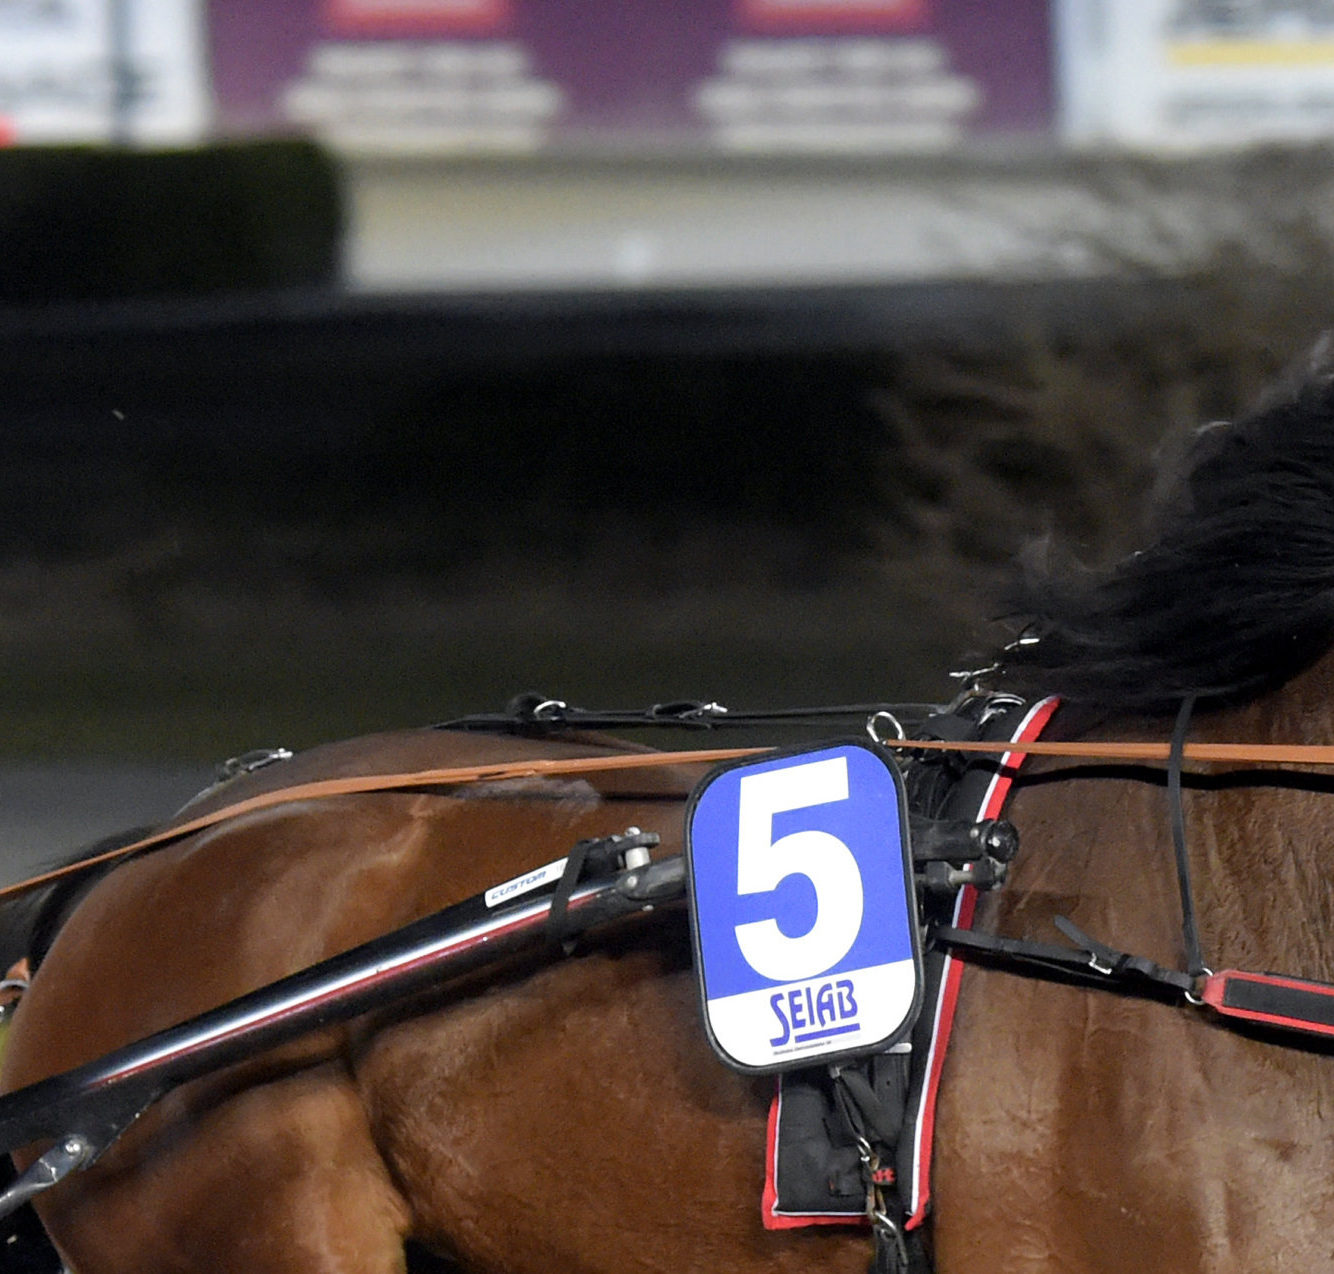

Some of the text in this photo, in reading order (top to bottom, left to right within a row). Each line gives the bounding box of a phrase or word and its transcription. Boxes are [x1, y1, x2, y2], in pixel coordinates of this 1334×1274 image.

[491, 870, 547, 900] CUSTOM
[734, 756, 864, 982] 5
[769, 979, 859, 1048] SEIAB
